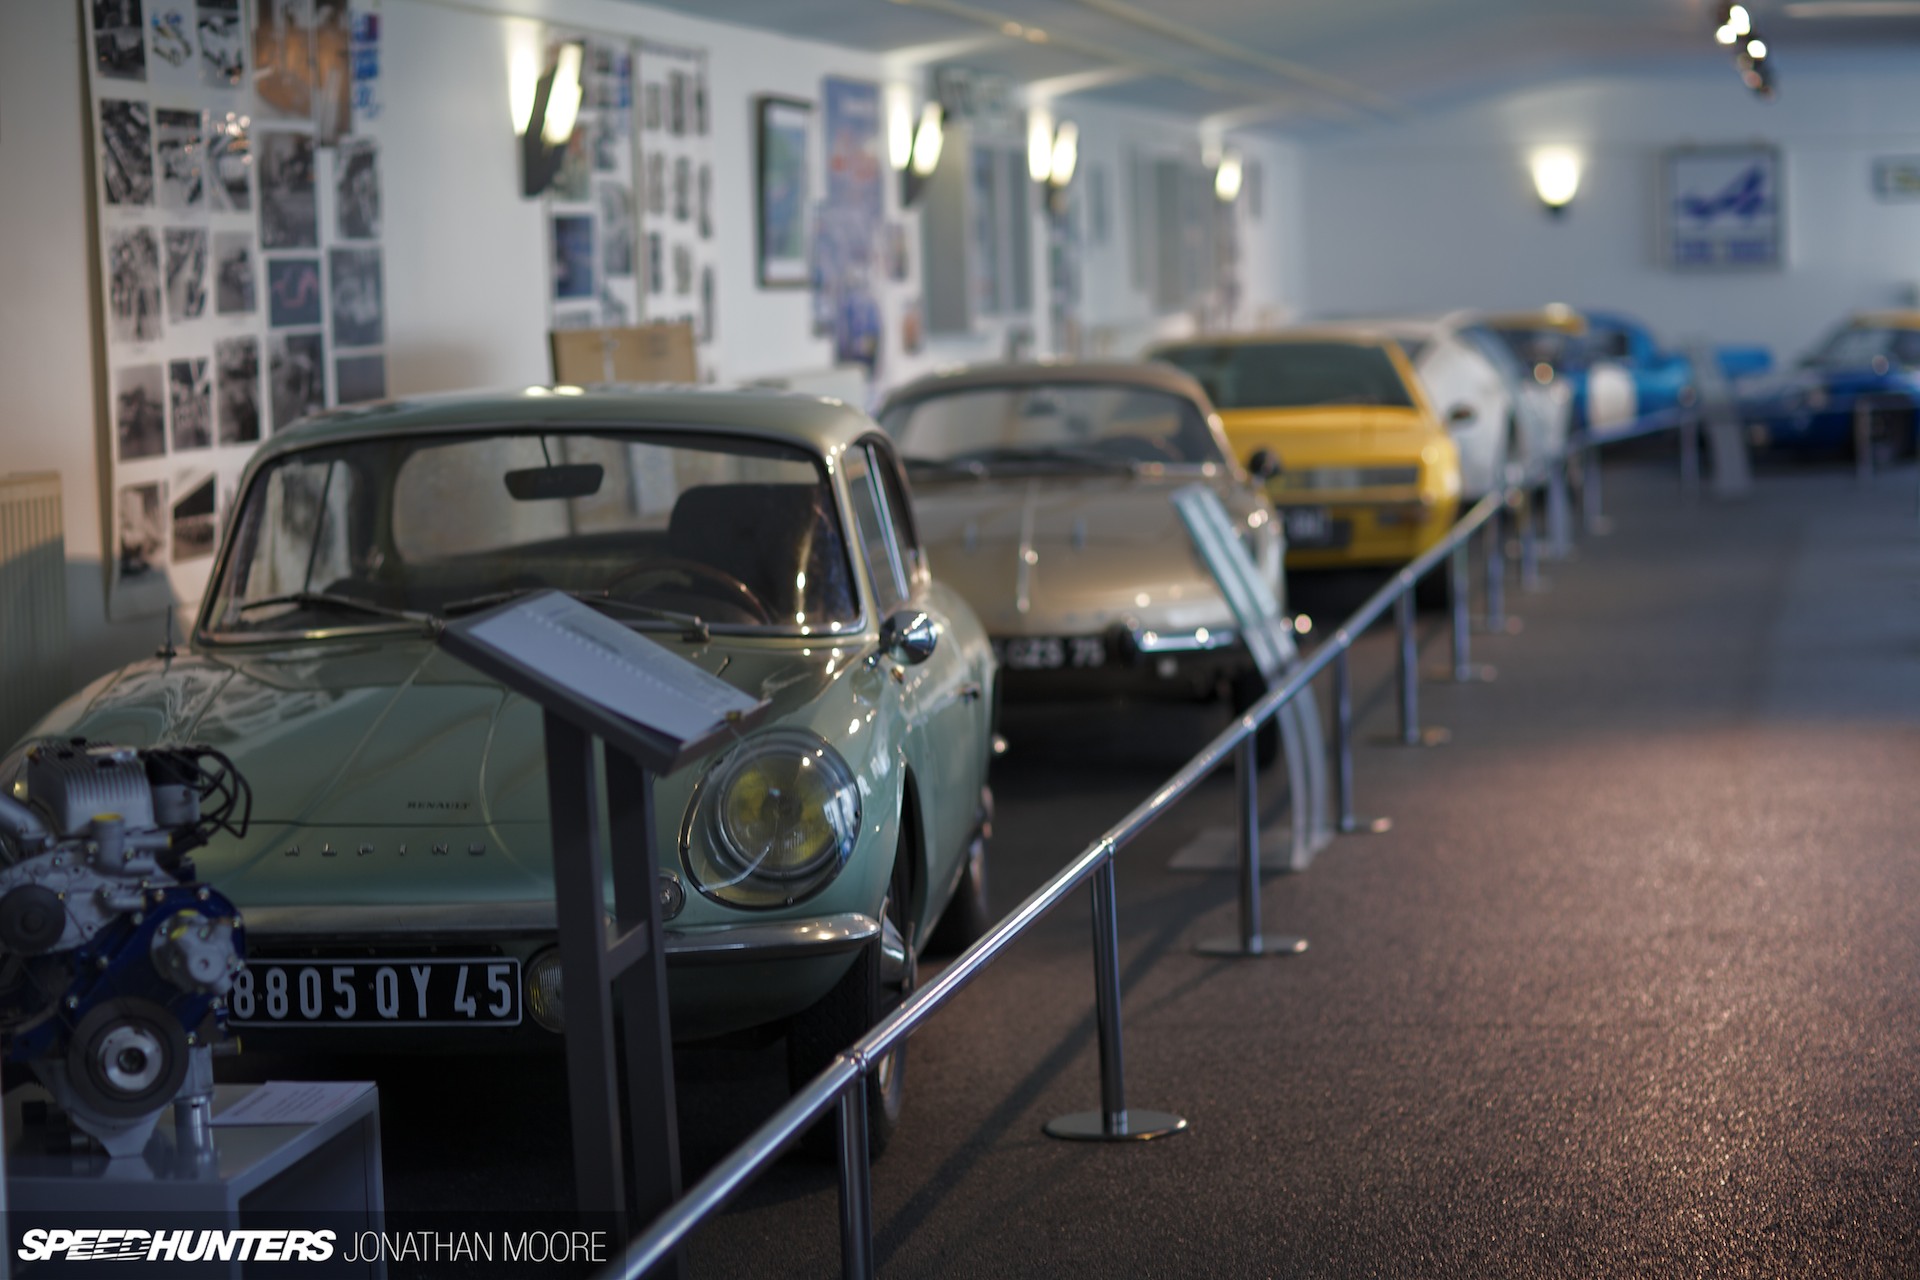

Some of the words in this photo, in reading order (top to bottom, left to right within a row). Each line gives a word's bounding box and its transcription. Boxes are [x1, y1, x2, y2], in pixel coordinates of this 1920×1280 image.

[406, 801, 471, 810] RENAULT
[284, 842, 486, 857] ALPINE
[233, 966, 356, 1019] 8805
[375, 965, 431, 1019] QY
[454, 964, 512, 1018] 45
